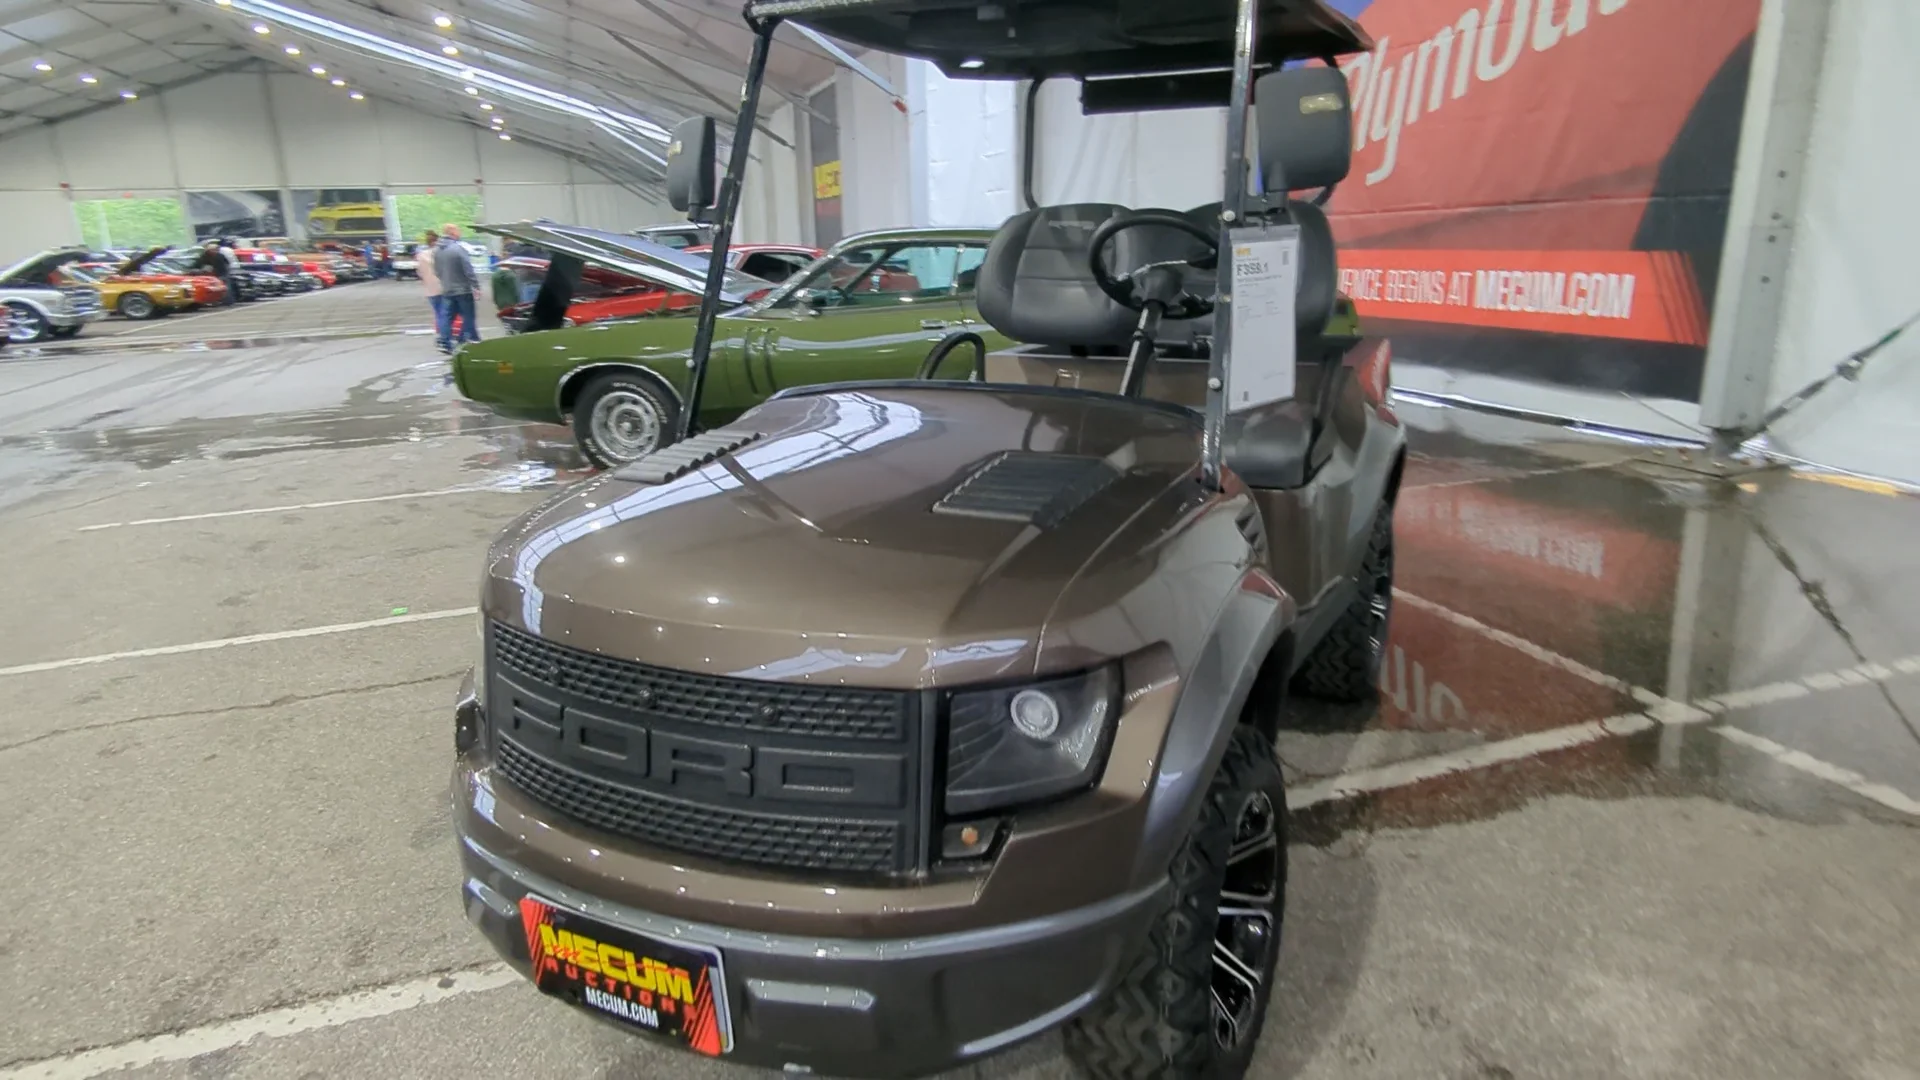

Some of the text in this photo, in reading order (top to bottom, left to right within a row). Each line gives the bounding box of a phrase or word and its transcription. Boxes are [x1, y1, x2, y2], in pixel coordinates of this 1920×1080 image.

[1385, 269, 1446, 306] BEGINS
[1447, 271, 1472, 307] AT
[1474, 270, 1635, 319] MECUM.COM
[497, 672, 906, 807] FORD
[539, 922, 695, 1005] MECUM
[586, 985, 660, 1029] MECUM.COM
